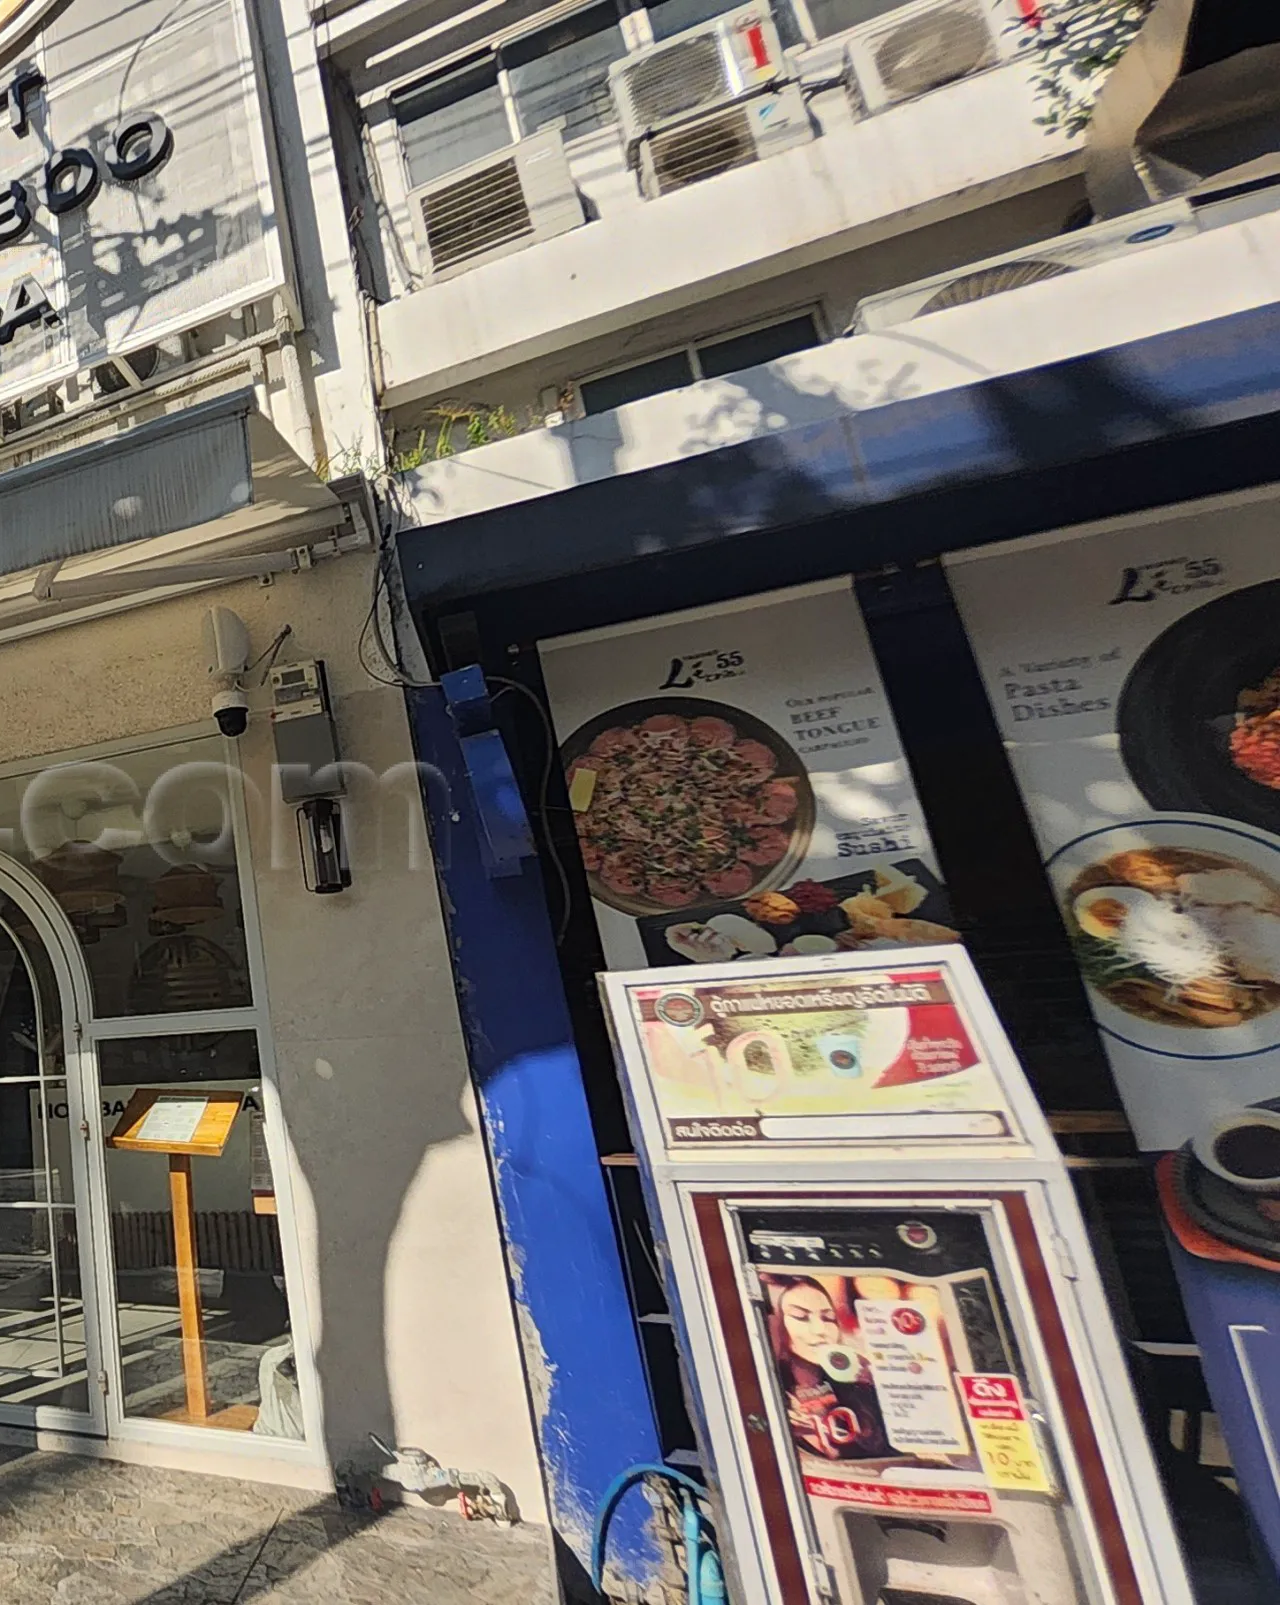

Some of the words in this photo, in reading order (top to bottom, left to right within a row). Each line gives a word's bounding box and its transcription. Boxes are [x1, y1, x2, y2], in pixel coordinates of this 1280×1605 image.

[716, 650, 745, 669] 55
[1004, 679, 1084, 700] Pasta
[790, 706, 842, 725] BEEF
[1012, 698, 1112, 722] Dishes
[793, 717, 881, 741] TONGUE
[837, 836, 917, 857] Sushi
